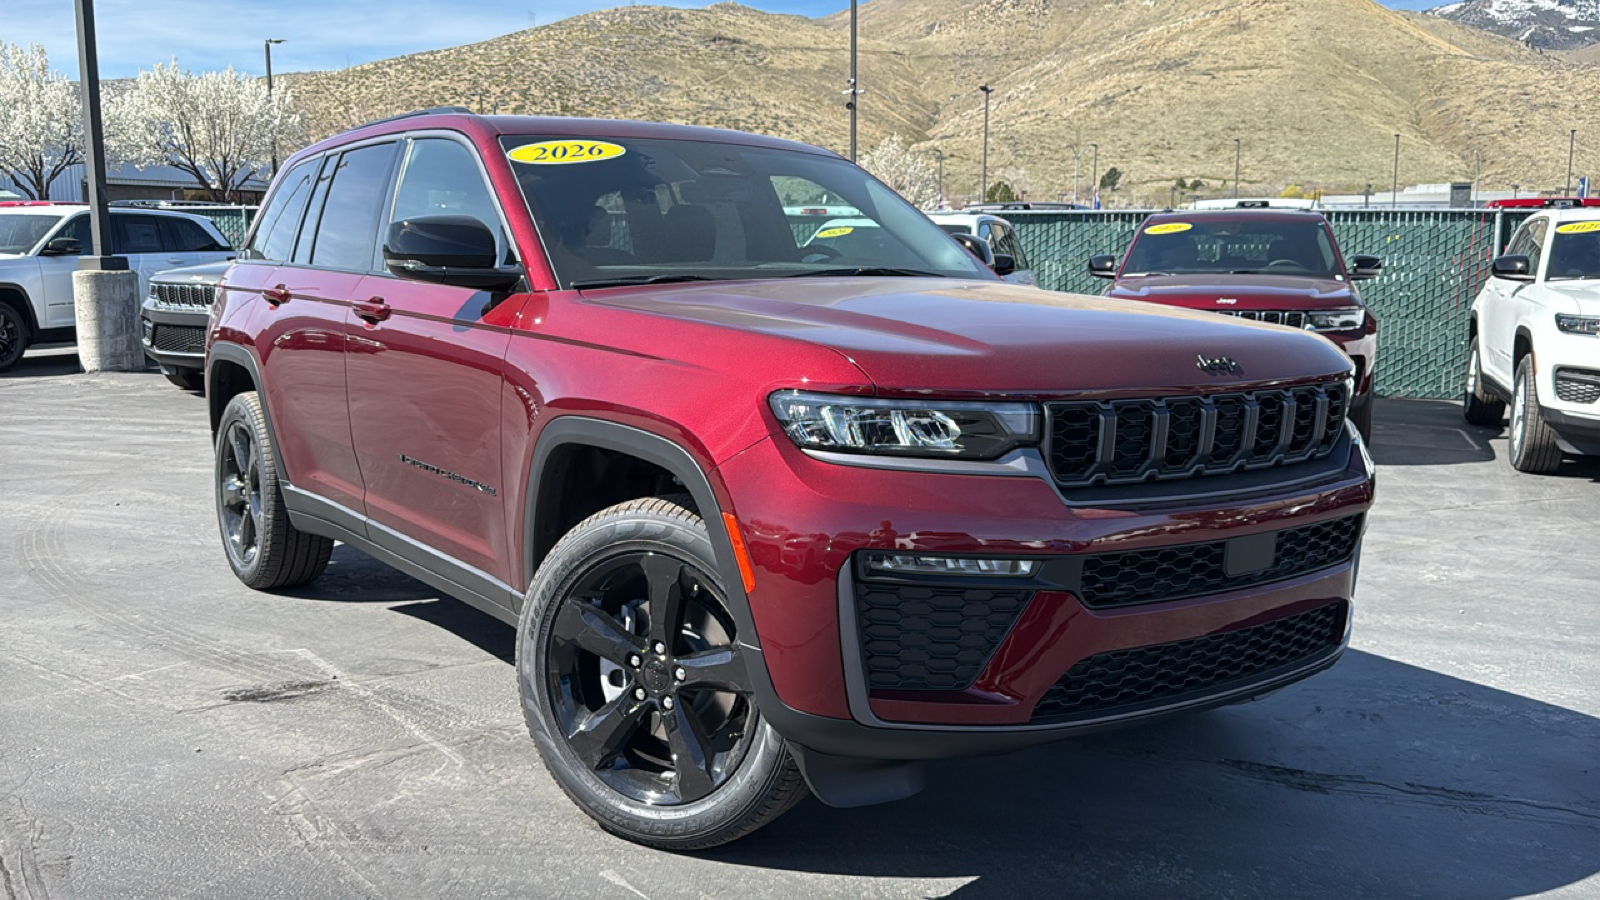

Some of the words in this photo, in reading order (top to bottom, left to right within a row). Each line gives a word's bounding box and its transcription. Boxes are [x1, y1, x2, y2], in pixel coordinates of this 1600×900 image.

[533, 143, 604, 161] 2026
[1216, 297, 1237, 305] Jeep
[1196, 354, 1237, 373] Jeep
